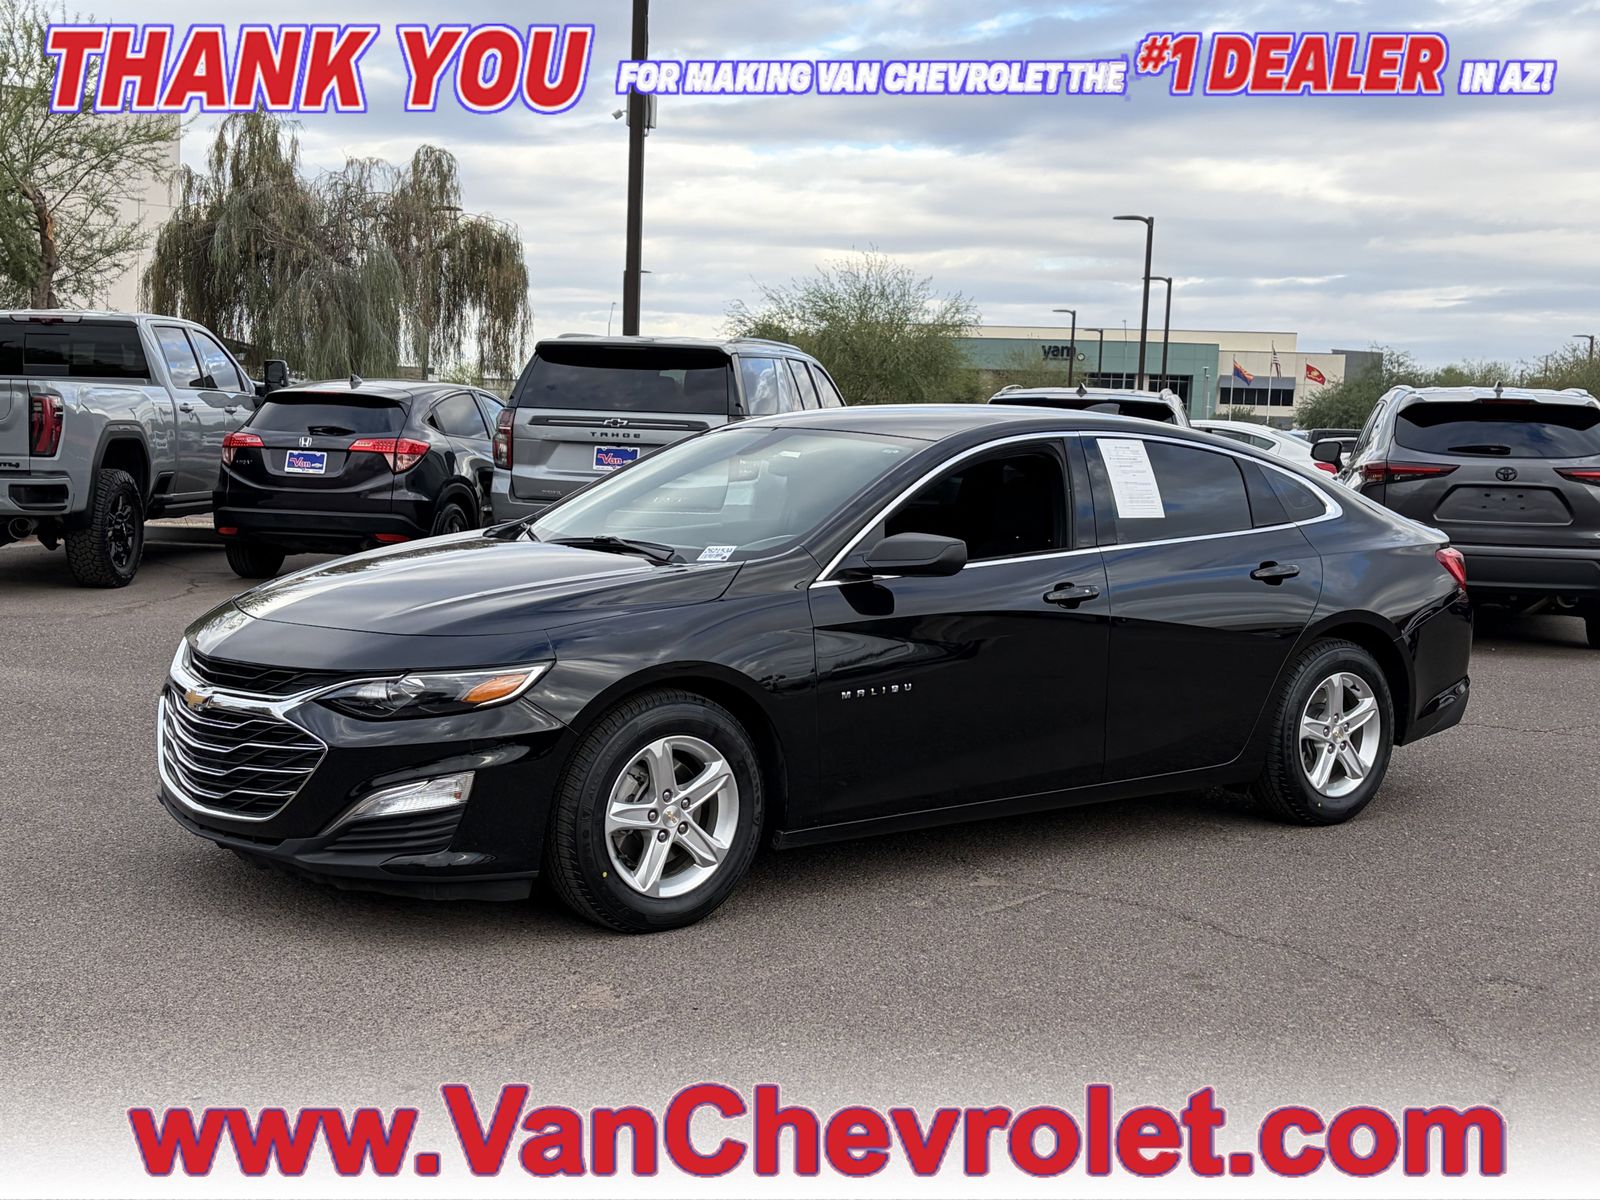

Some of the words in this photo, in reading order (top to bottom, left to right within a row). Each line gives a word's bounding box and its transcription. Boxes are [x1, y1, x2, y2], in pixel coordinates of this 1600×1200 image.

[290, 457, 311, 468] Van
[598, 453, 623, 464] Van
[841, 683, 912, 699] MALIBU
